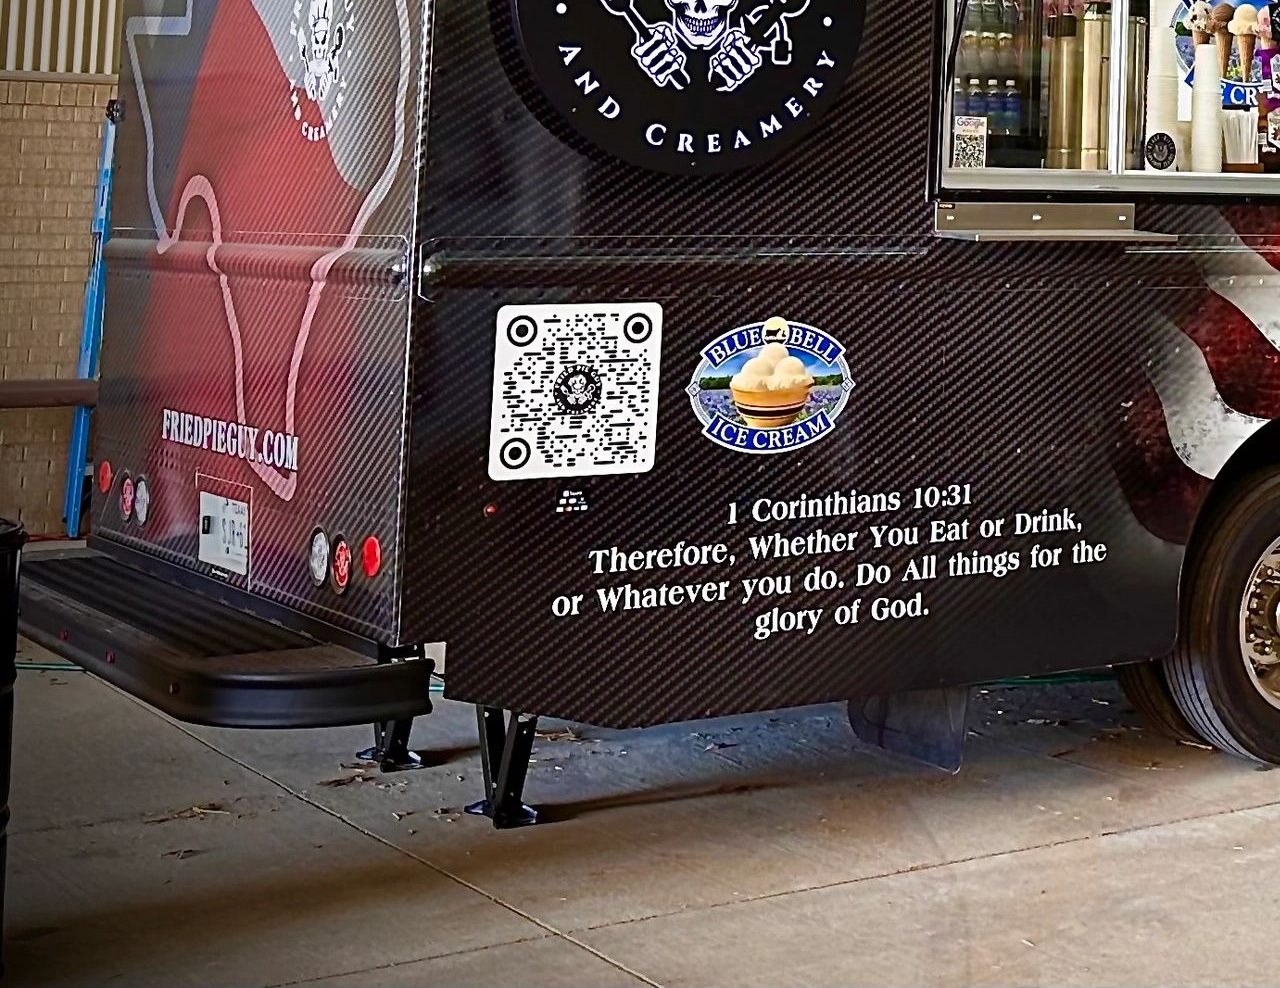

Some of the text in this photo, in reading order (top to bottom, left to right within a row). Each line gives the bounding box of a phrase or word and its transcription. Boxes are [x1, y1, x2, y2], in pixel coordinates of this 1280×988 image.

[557, 43, 837, 154] AND CREAMERY
[956, 116, 985, 129] Google
[708, 327, 836, 366] BLUE BELL
[161, 408, 299, 472] FRIEDPIEGUY.COM
[710, 416, 828, 449] ICE CREAM
[726, 483, 972, 525] 1 Corinthians 10:31
[588, 507, 1083, 574] Therefore, Whether You Eat or Drink,
[551, 539, 1108, 618] or Whatever you do. Do All things for the
[753, 592, 930, 641] glory of God.
